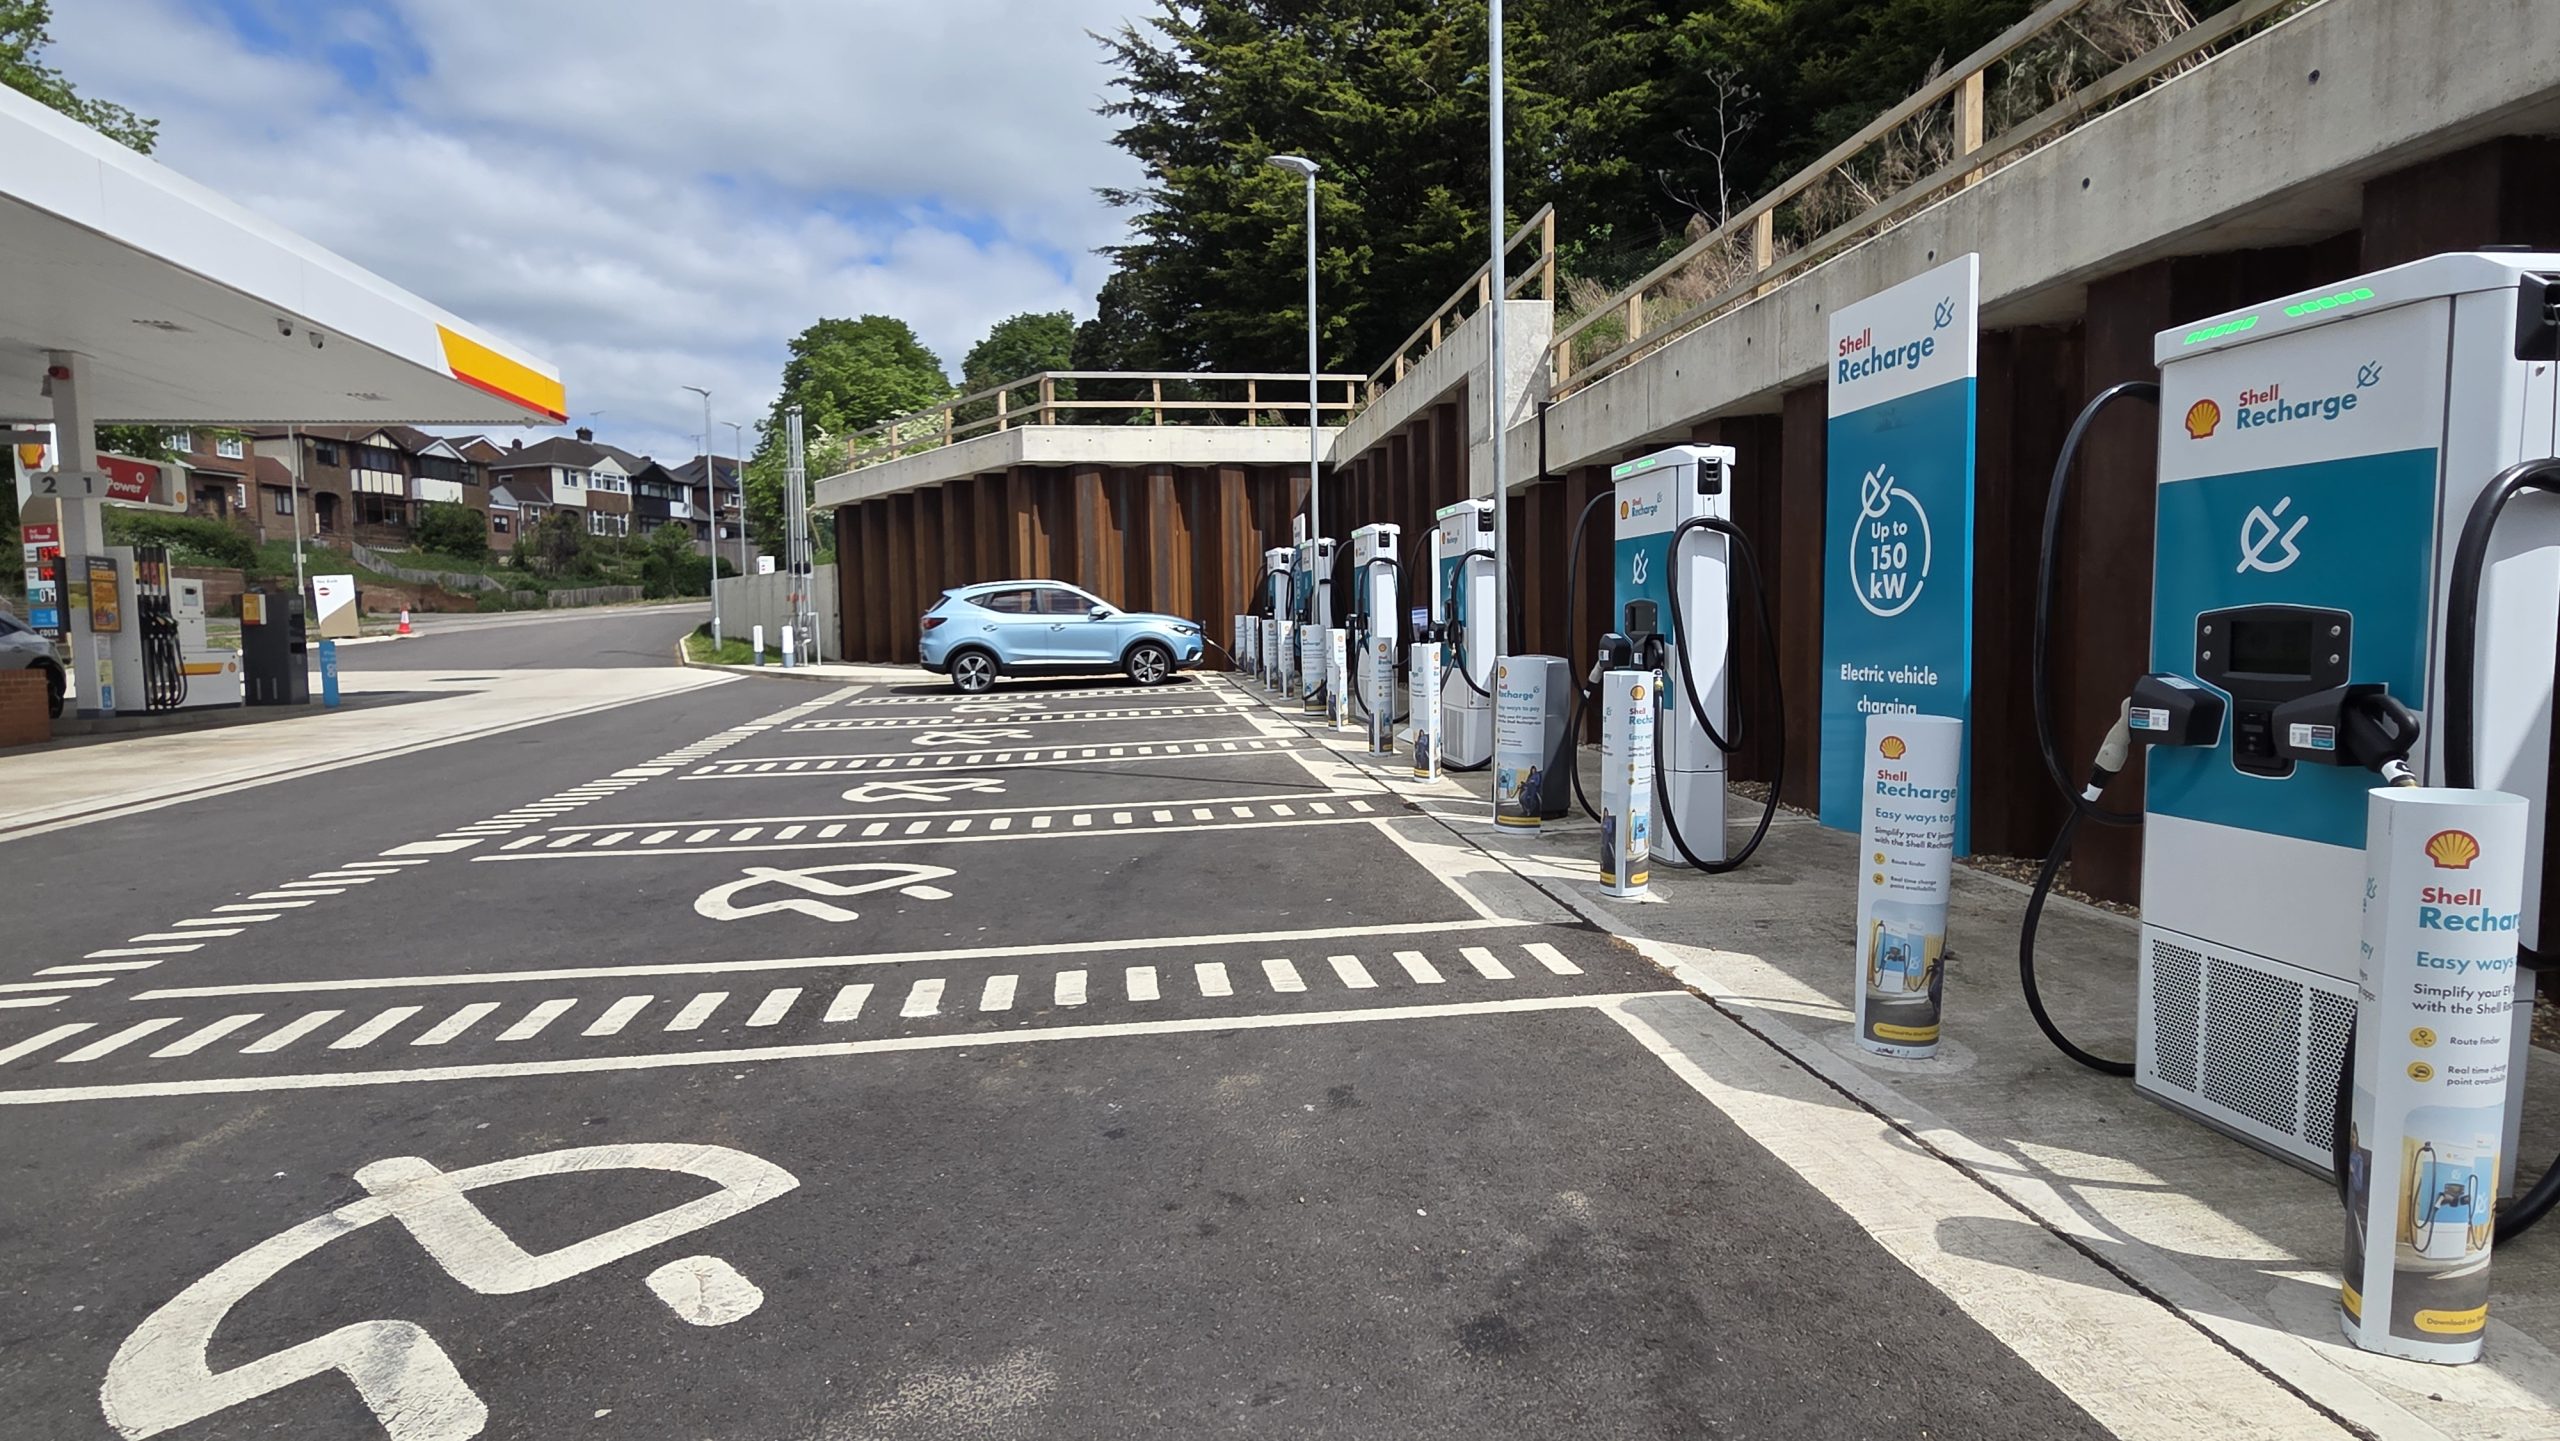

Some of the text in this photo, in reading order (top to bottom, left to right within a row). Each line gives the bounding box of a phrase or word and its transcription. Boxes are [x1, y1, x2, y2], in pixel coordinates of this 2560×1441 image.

[1839, 327, 1871, 357] Shell
[1838, 337, 1935, 384] Recharge
[2239, 384, 2279, 407] Shell
[2237, 393, 2357, 430] Recharge
[41, 476, 92, 494] 2 1
[106, 478, 142, 494] Power
[1632, 504, 1658, 517] Recharge
[1871, 521, 1908, 542] Up to
[1871, 542, 1908, 571] 150
[1870, 572, 1907, 600] kW
[1840, 663, 1938, 686] Electric vehicle
[1877, 769, 1907, 782] Shell
[1876, 807, 1901, 822] Easy
[1905, 813, 1937, 825] ways
[1939, 814, 1949, 823] to
[1875, 826, 1904, 839] Simplify
[1906, 831, 1925, 839] your
[1891, 839, 1904, 847] the
[1906, 840, 1925, 848] Shell
[2421, 887, 2482, 906] Shell
[2418, 906, 2521, 932] Rechar
[2416, 951, 2514, 975] Easy ways
[2413, 983, 2475, 1001] Simplify
[2477, 989, 2502, 1001] your
[2412, 1001, 2446, 1013] with
[2450, 1003, 2473, 1015] the
[2476, 1001, 2502, 1015] Shell
[2449, 1036, 2502, 1046] Route finder
[2448, 1066, 2470, 1074] Real
[2471, 1066, 2490, 1075] time
[2446, 1078, 2473, 1087] point
[2426, 1317, 2467, 1327] Download
